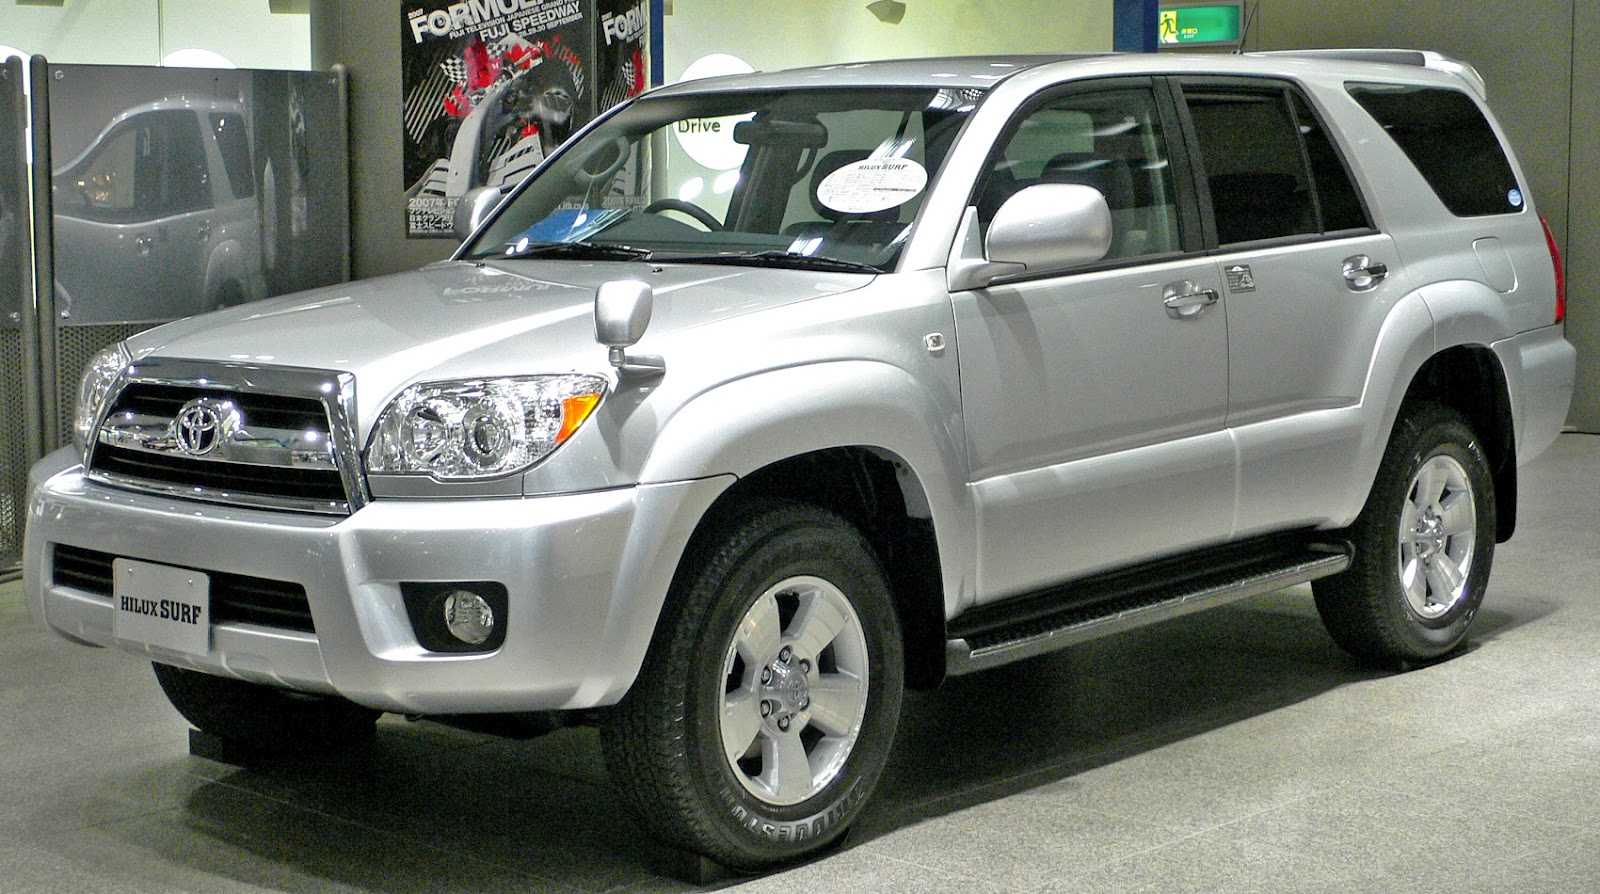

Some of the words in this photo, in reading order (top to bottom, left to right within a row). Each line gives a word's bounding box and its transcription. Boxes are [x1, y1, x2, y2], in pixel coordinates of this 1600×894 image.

[409, 0, 544, 44] FORMUL
[479, 23, 511, 42] FUJI
[512, 0, 580, 32] SPEEDWAY
[678, 117, 721, 133] Drive
[120, 595, 158, 617] HILUX
[160, 599, 202, 625] SURF
